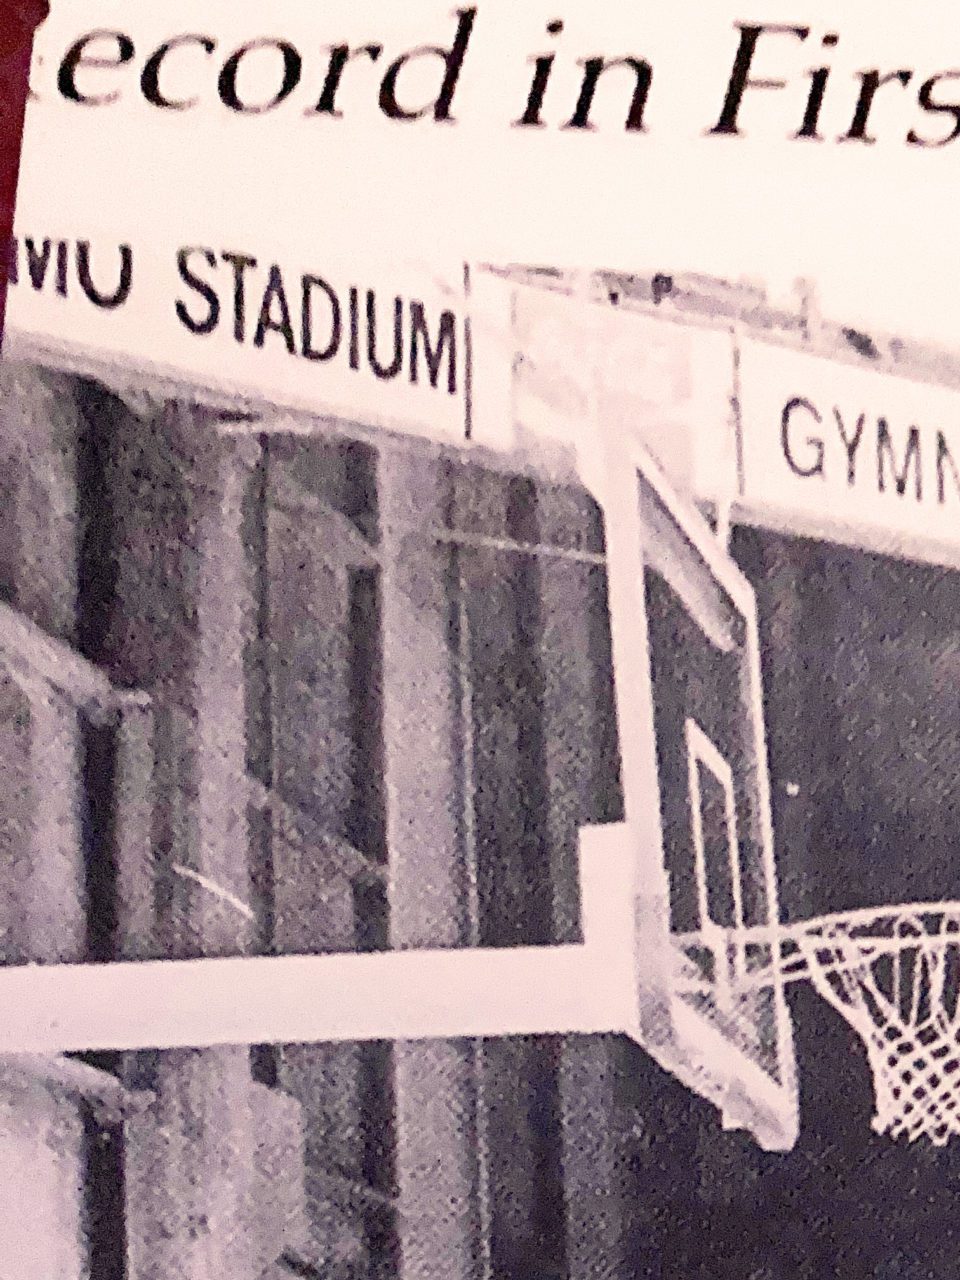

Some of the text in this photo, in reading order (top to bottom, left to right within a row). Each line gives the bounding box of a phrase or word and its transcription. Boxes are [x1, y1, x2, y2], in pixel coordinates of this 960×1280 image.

[30, 6, 478, 125] ecord
[512, 19, 653, 133] in
[174, 245, 458, 395] STADIUM
